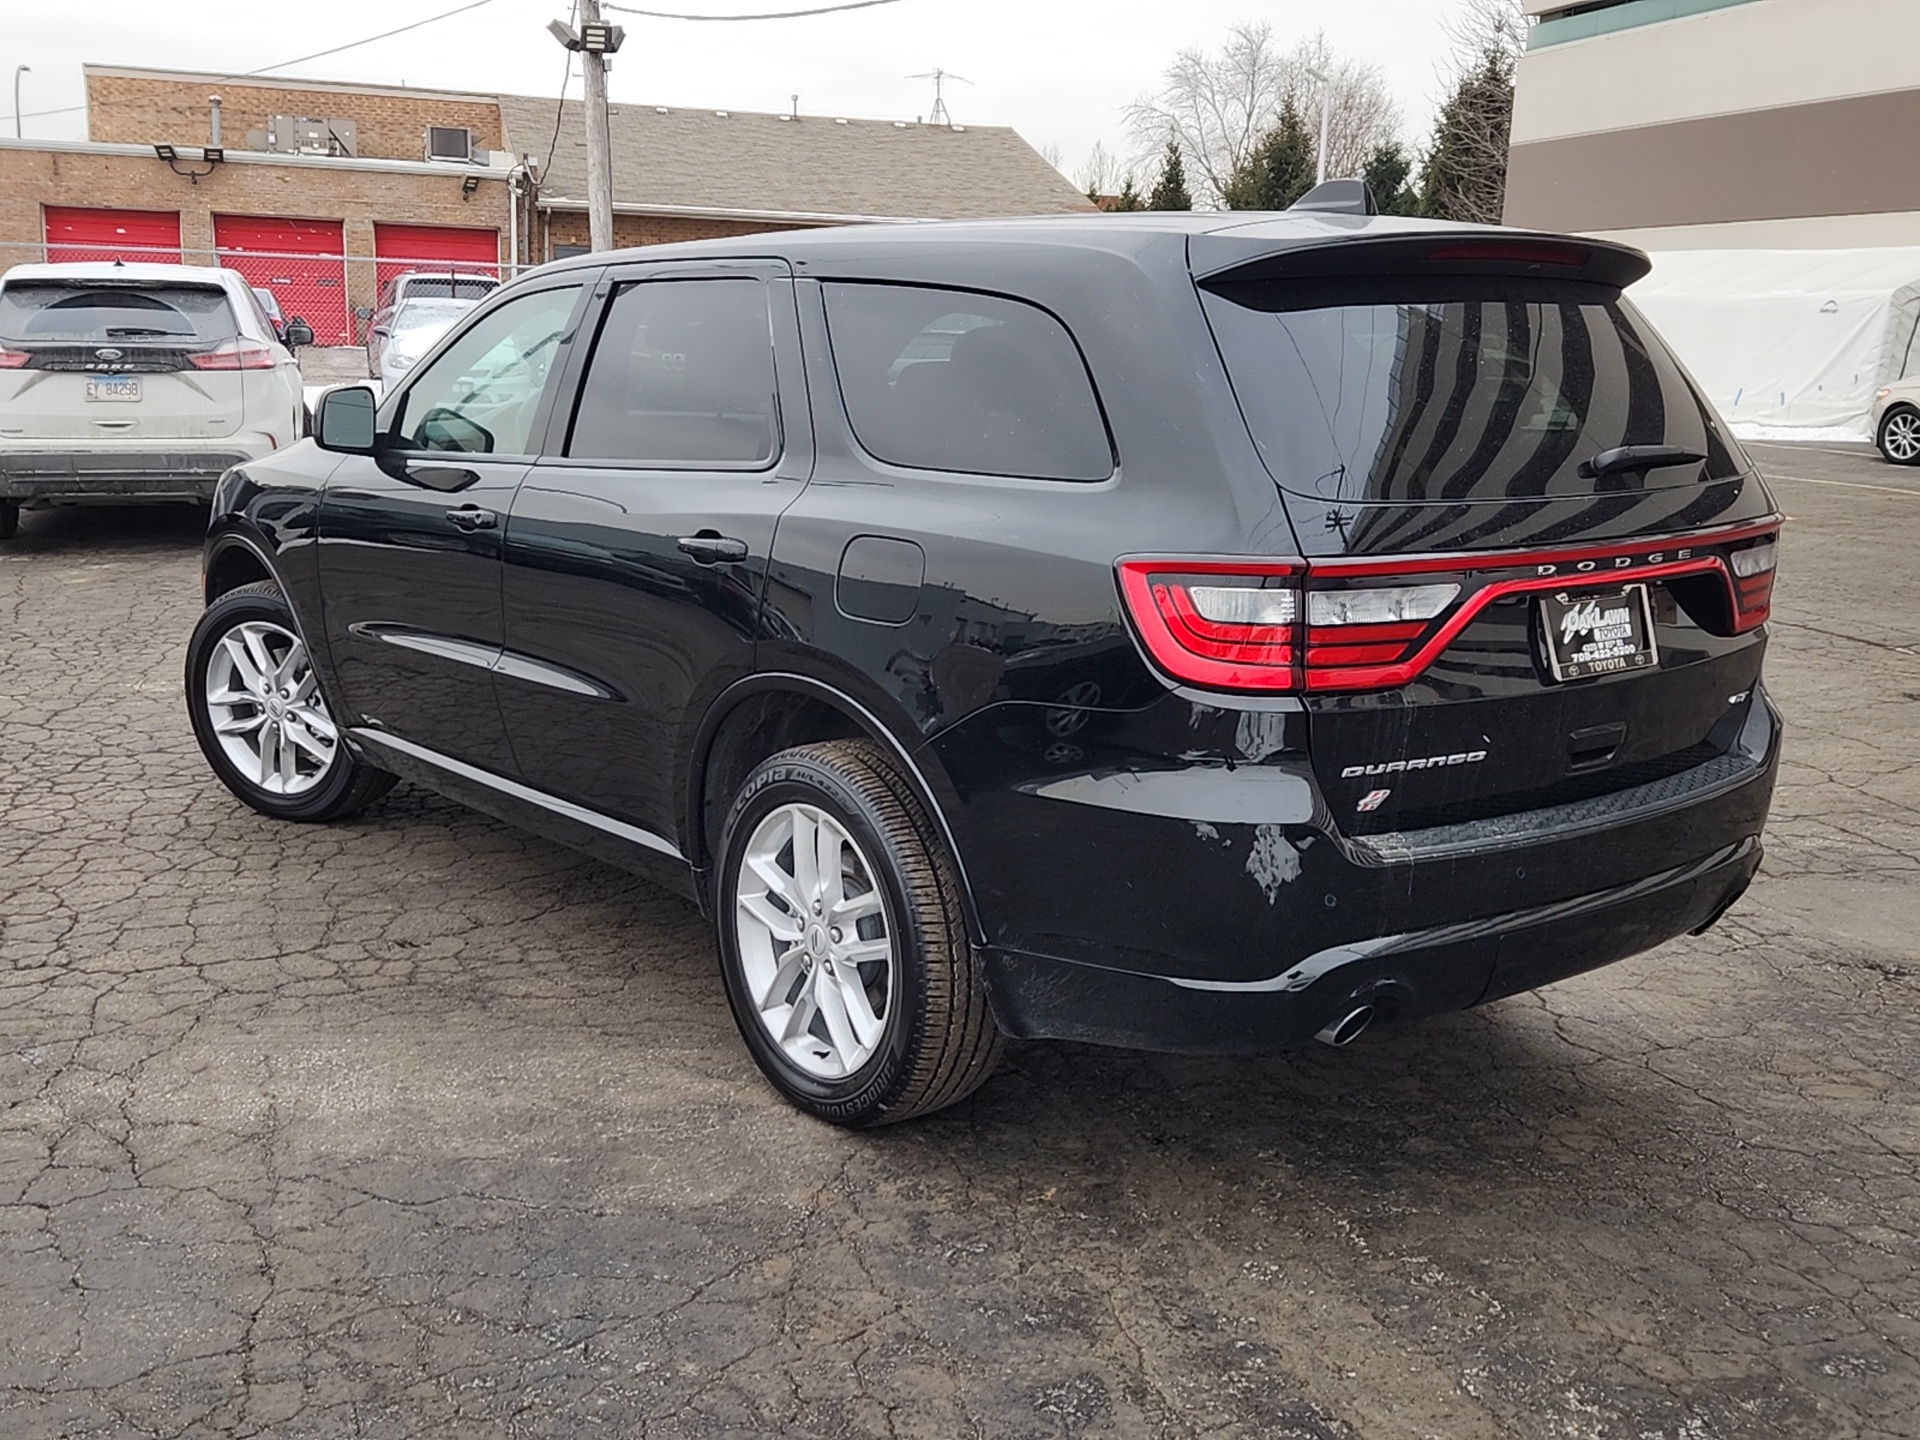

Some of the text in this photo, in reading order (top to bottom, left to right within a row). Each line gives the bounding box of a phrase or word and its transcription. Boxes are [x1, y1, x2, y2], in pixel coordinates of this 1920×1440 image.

[86, 383, 98, 396] EY
[1537, 549, 1692, 575] DODGE
[1599, 628, 1628, 639] TOYOTA
[1571, 644, 1636, 662] 708-423-5200
[1588, 657, 1627, 673] TOYOTA
[1341, 751, 1487, 778] DURANGO
